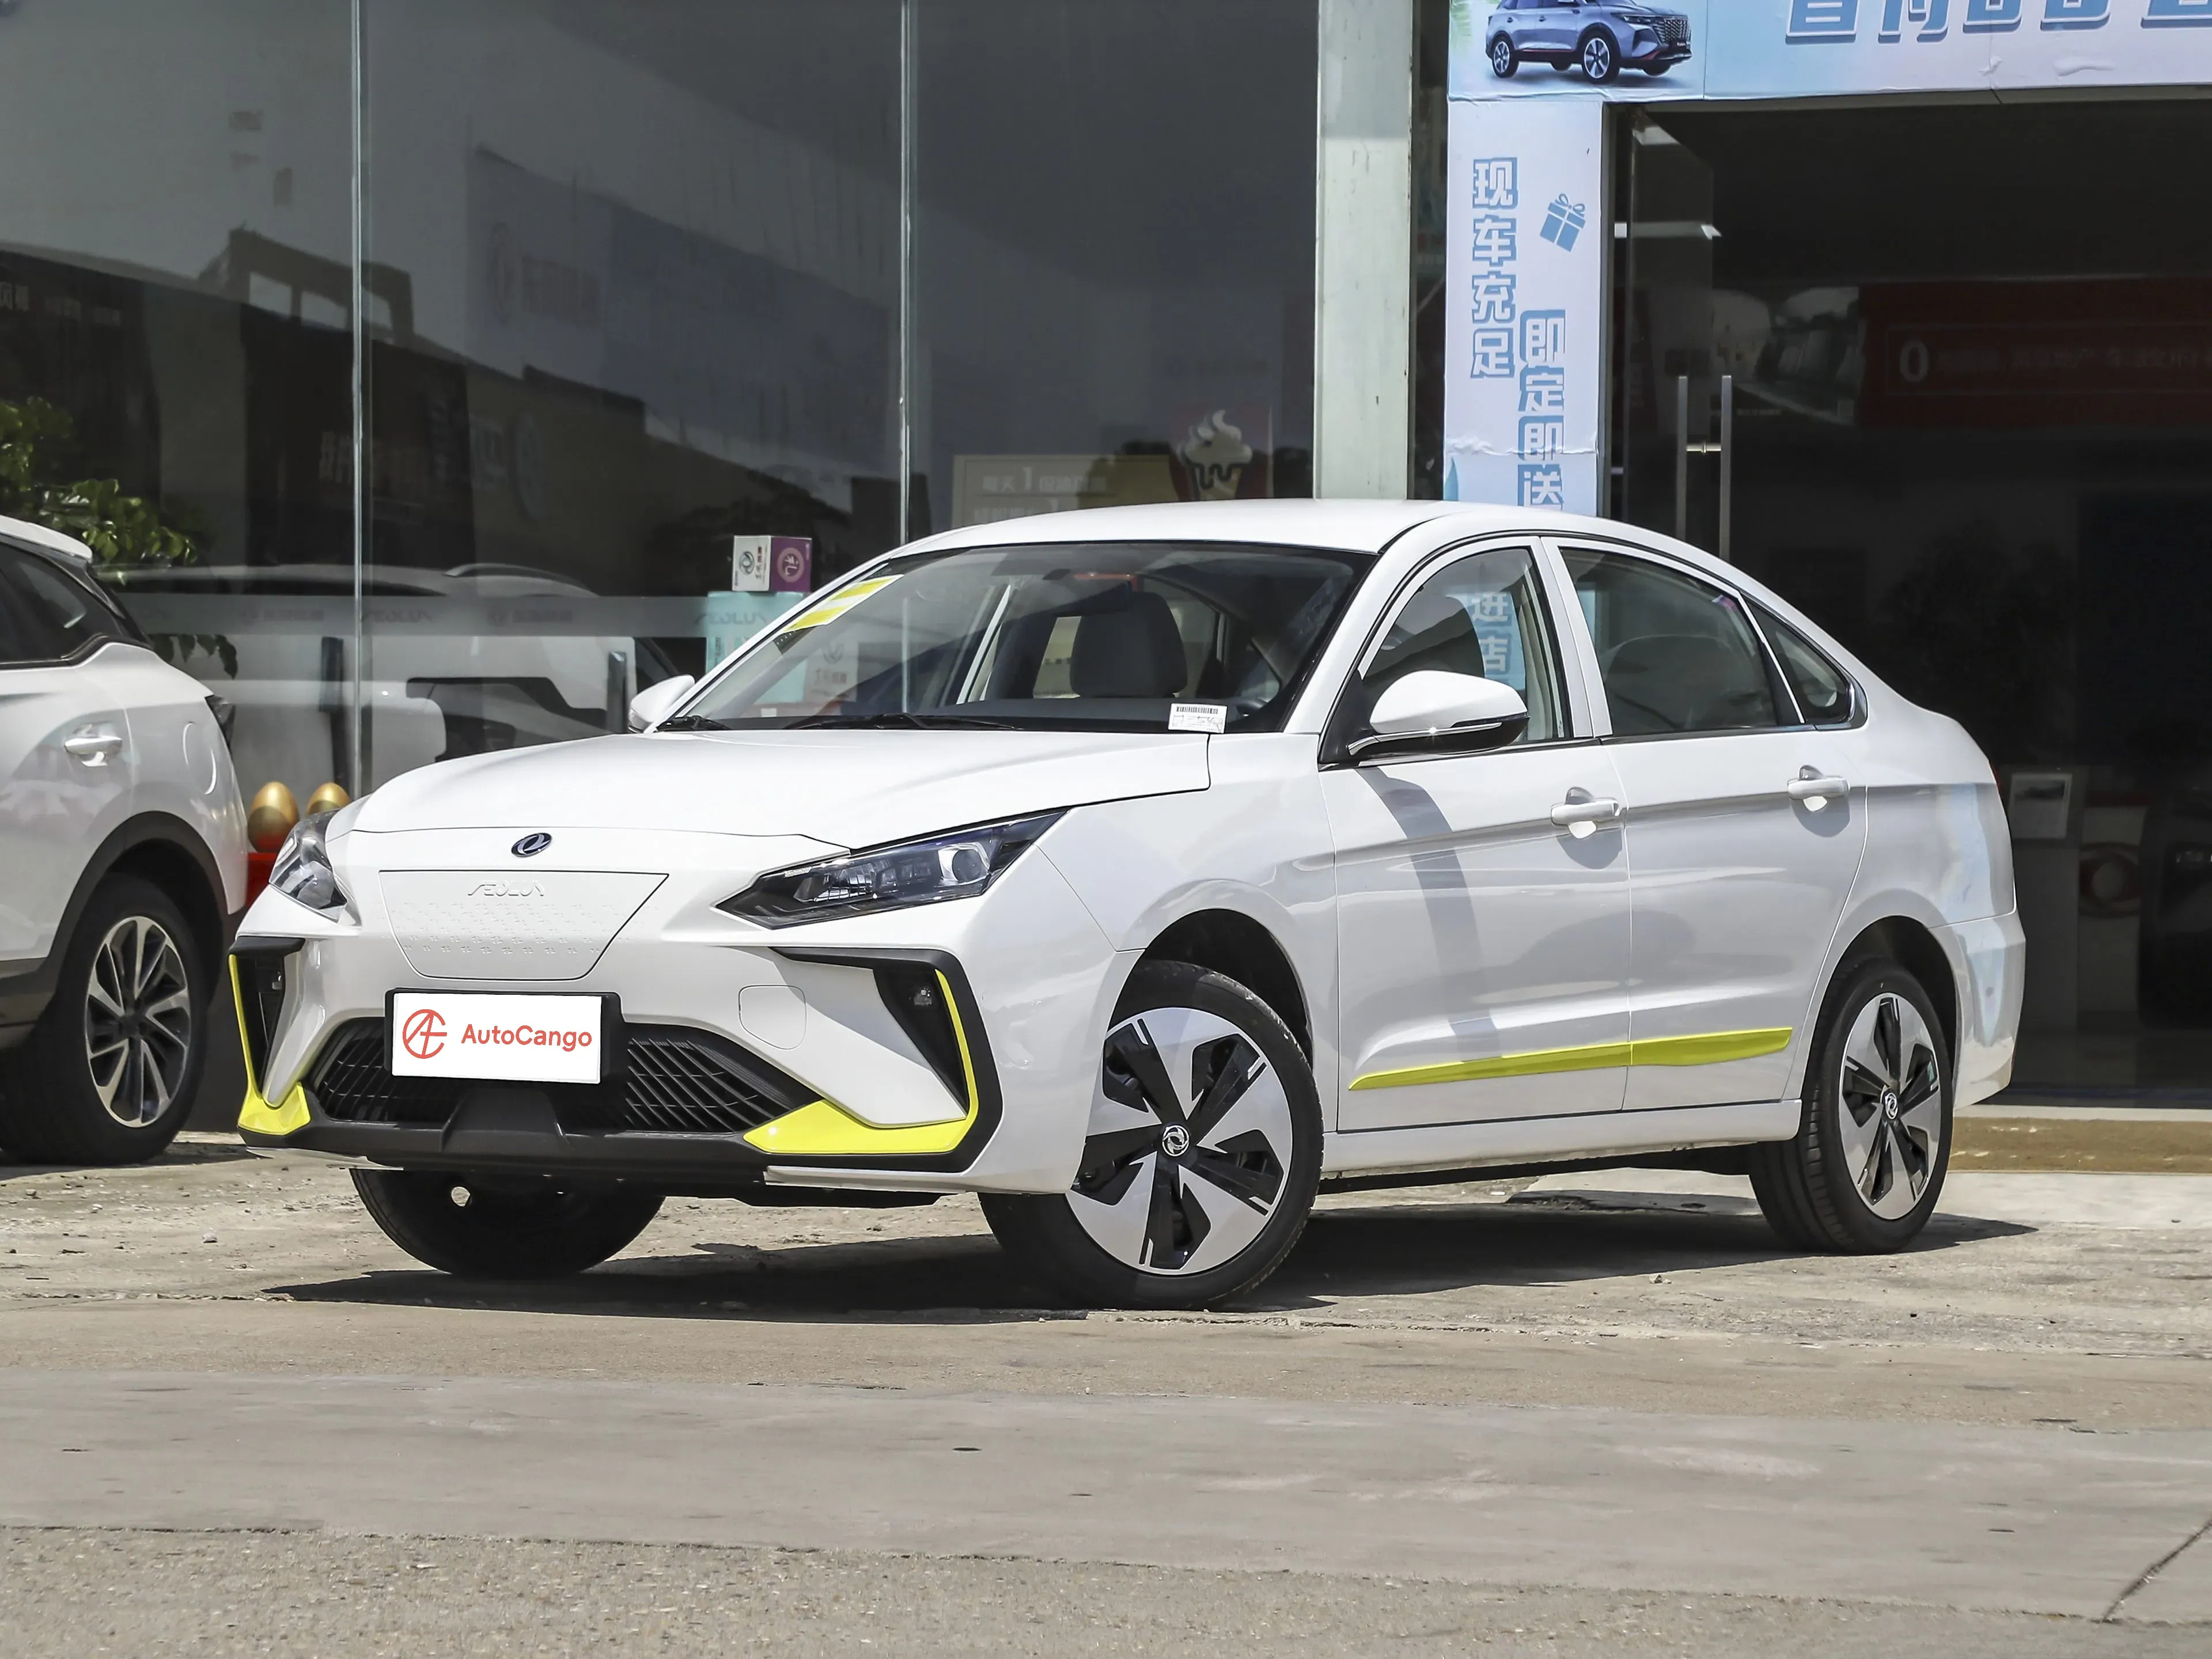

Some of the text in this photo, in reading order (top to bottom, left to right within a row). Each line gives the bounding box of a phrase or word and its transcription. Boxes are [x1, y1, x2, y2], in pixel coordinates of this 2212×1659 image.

[1471, 157, 1518, 378] 现车充足
[1518, 310, 1565, 510] 即定即送
